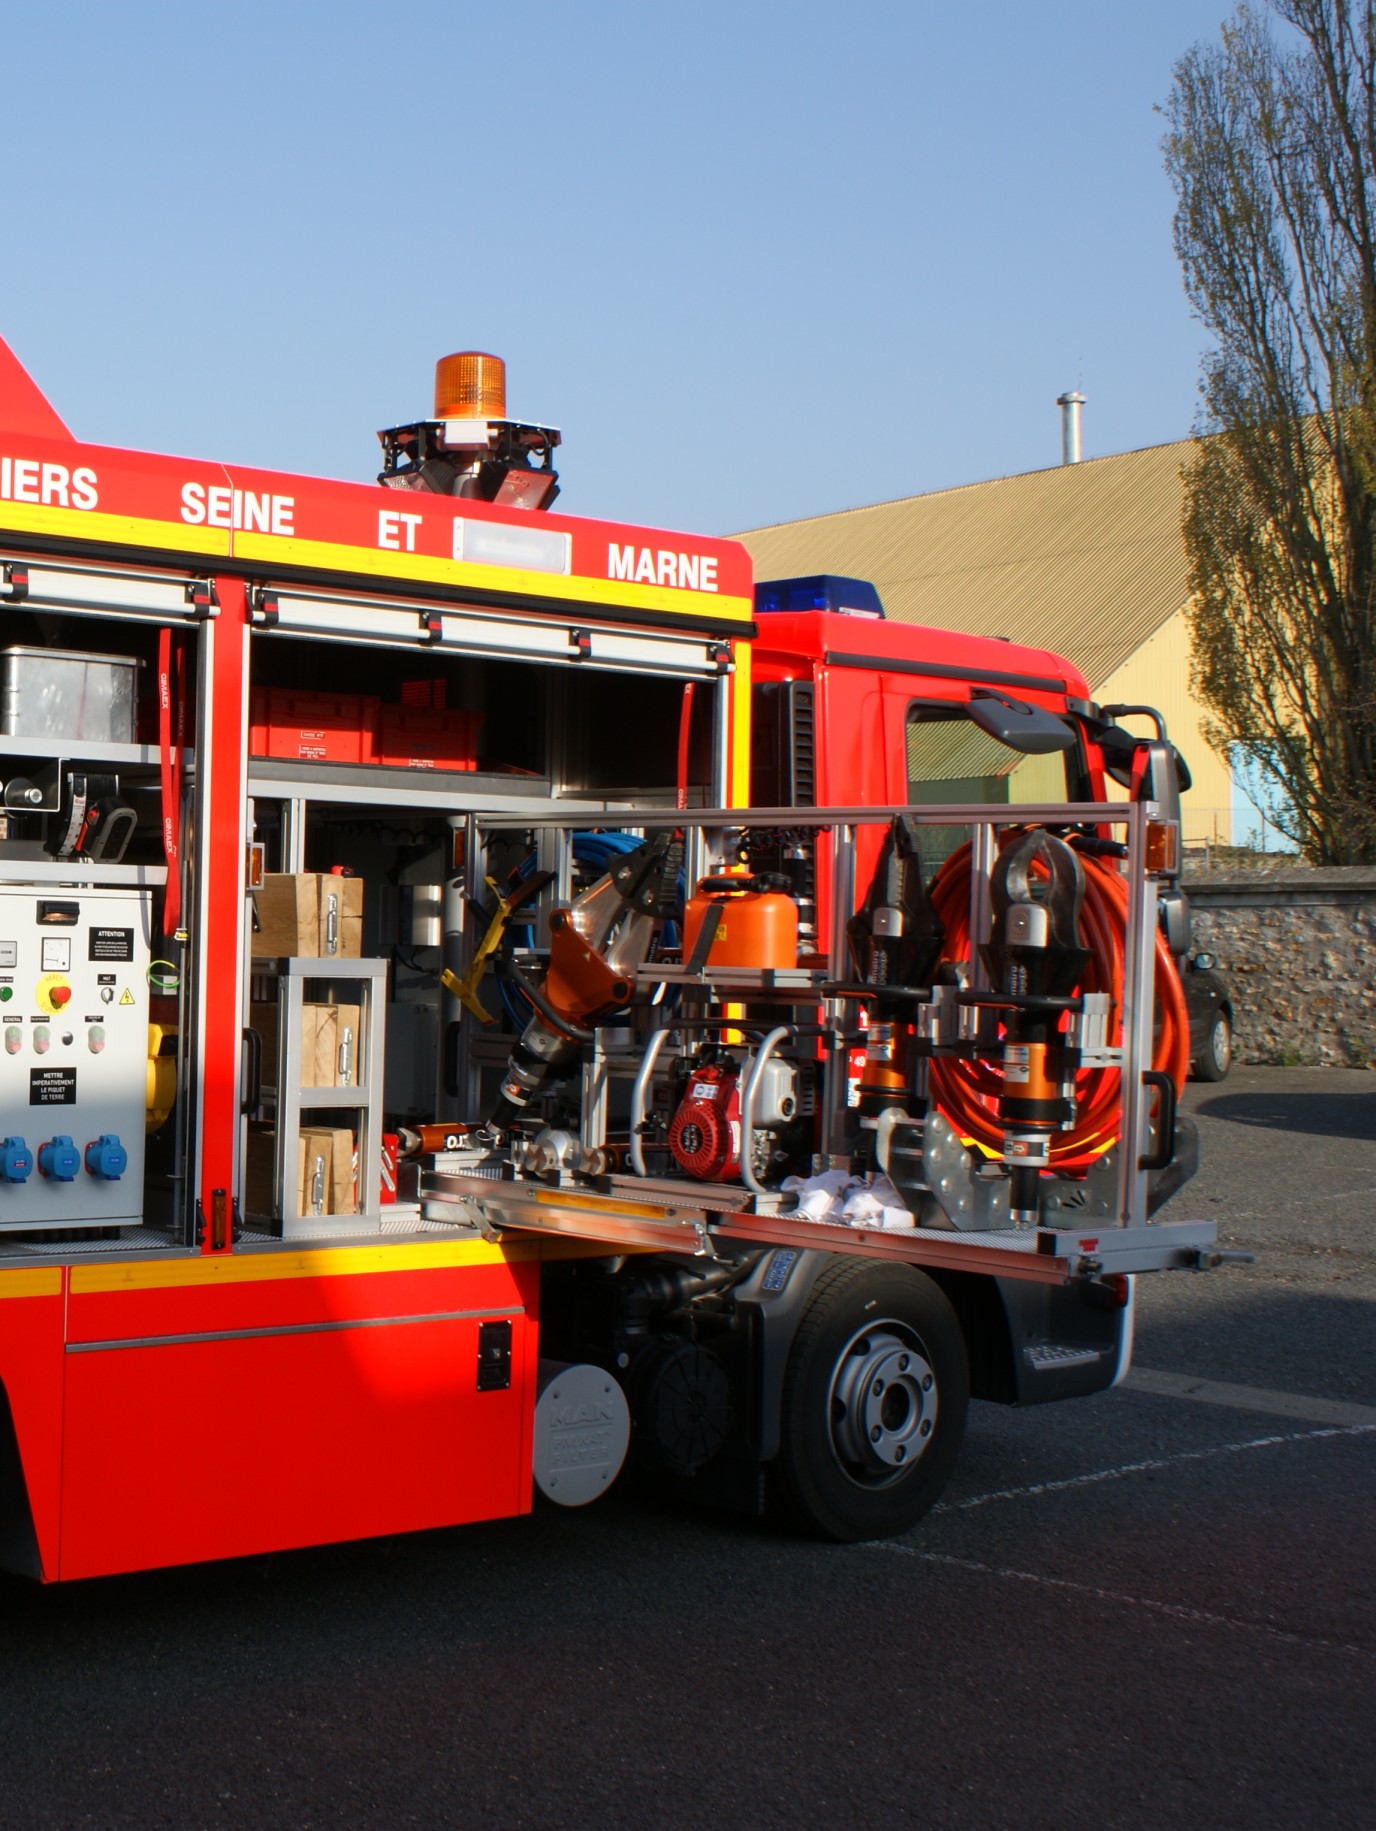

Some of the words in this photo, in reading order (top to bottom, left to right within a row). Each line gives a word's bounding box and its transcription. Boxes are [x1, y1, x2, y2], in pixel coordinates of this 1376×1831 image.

[180, 482, 294, 536] SEINE
[378, 510, 422, 552] ET
[608, 542, 718, 593] MARNE
[160, 673, 168, 709] GIMAEX
[549, 1400, 614, 1427] MAN
